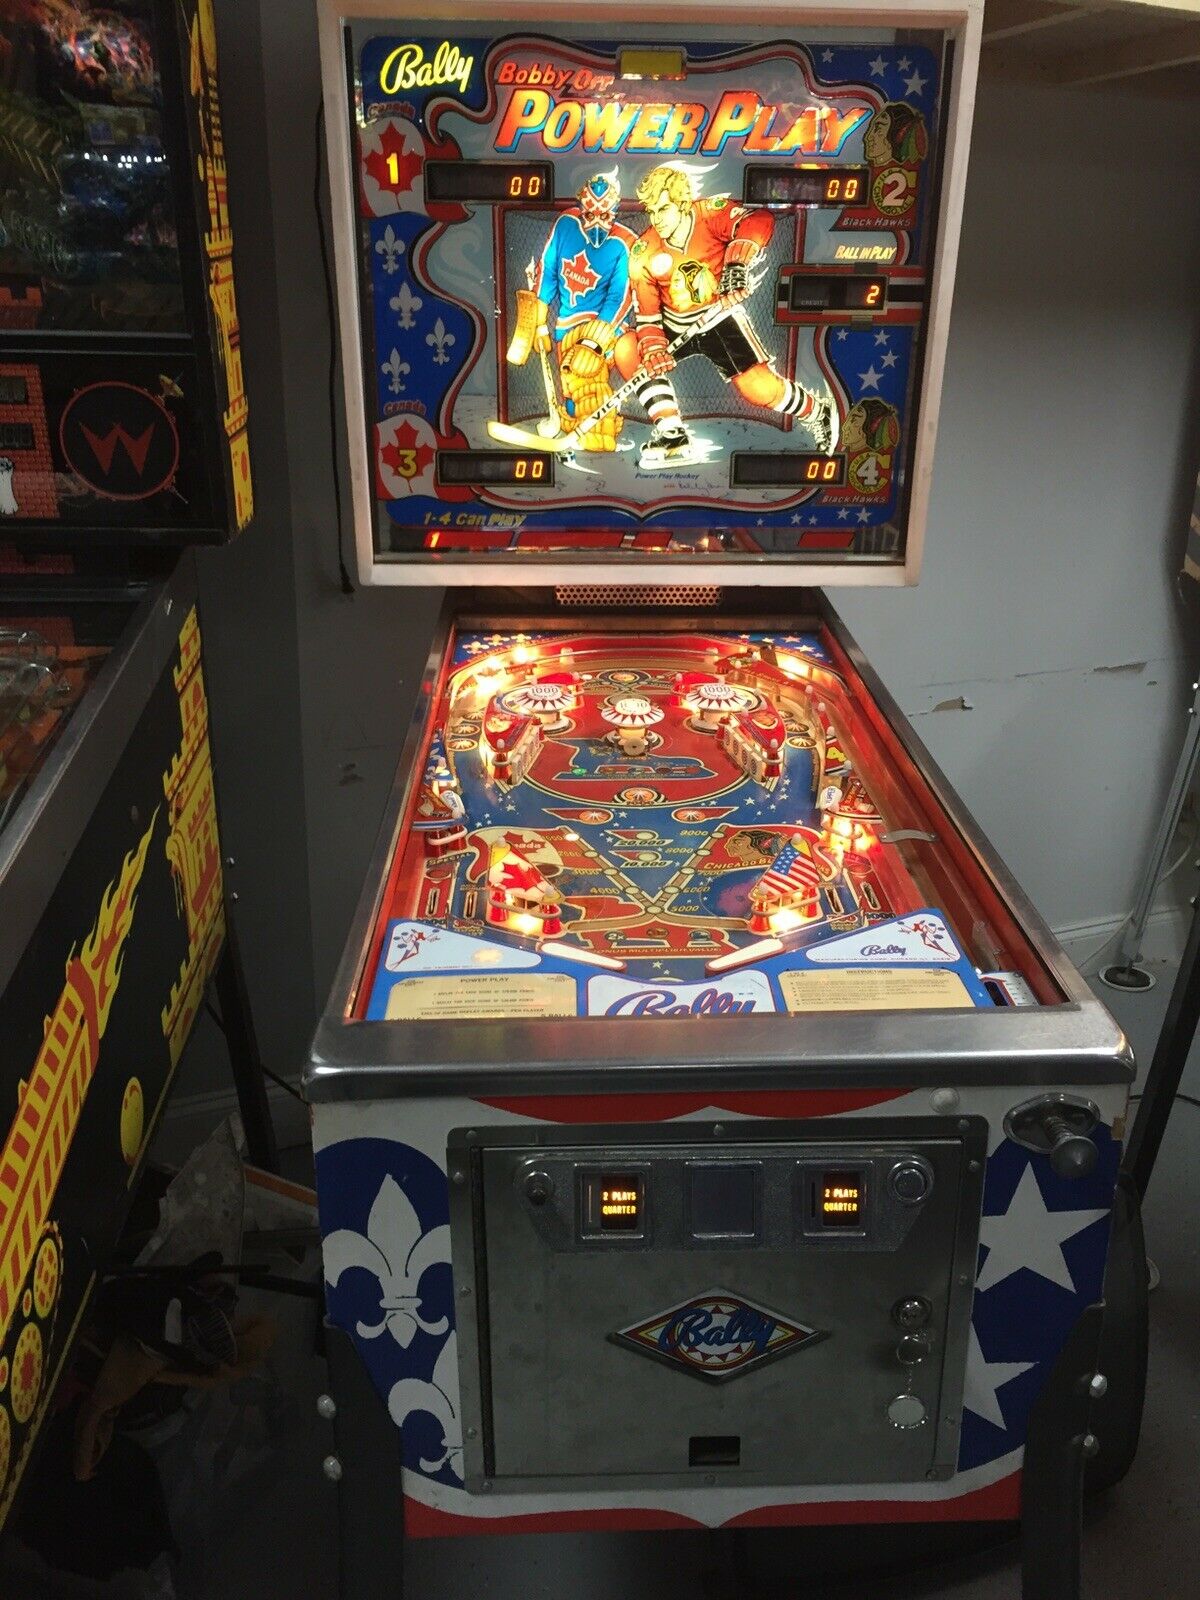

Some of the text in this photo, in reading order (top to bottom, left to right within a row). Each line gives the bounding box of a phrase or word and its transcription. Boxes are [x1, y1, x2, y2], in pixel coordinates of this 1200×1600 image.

[380, 41, 473, 95] Bally
[498, 61, 574, 90] Bobby
[493, 87, 874, 157] POWER PLAY
[386, 153, 399, 184] 1
[882, 172, 907, 207] 2
[842, 216, 911, 226] Black Hawks
[834, 245, 898, 260] BALL IN PLAY
[564, 268, 590, 286] CANADA
[866, 285, 880, 304] 2
[398, 449, 417, 477] 3
[856, 456, 879, 486] 4
[424, 511, 452, 525] 1-4
[456, 512, 487, 526] Can
[429, 531, 441, 549] 1
[704, 860, 757, 870] CHICAGO
[860, 945, 906, 956] Bally
[612, 1191, 637, 1201] PLAYS
[824, 1188, 858, 1198] 2 PLAYS
[602, 1205, 637, 1215] QUARTER
[823, 1202, 858, 1212] QUARTER
[658, 1306, 776, 1354] Bally
